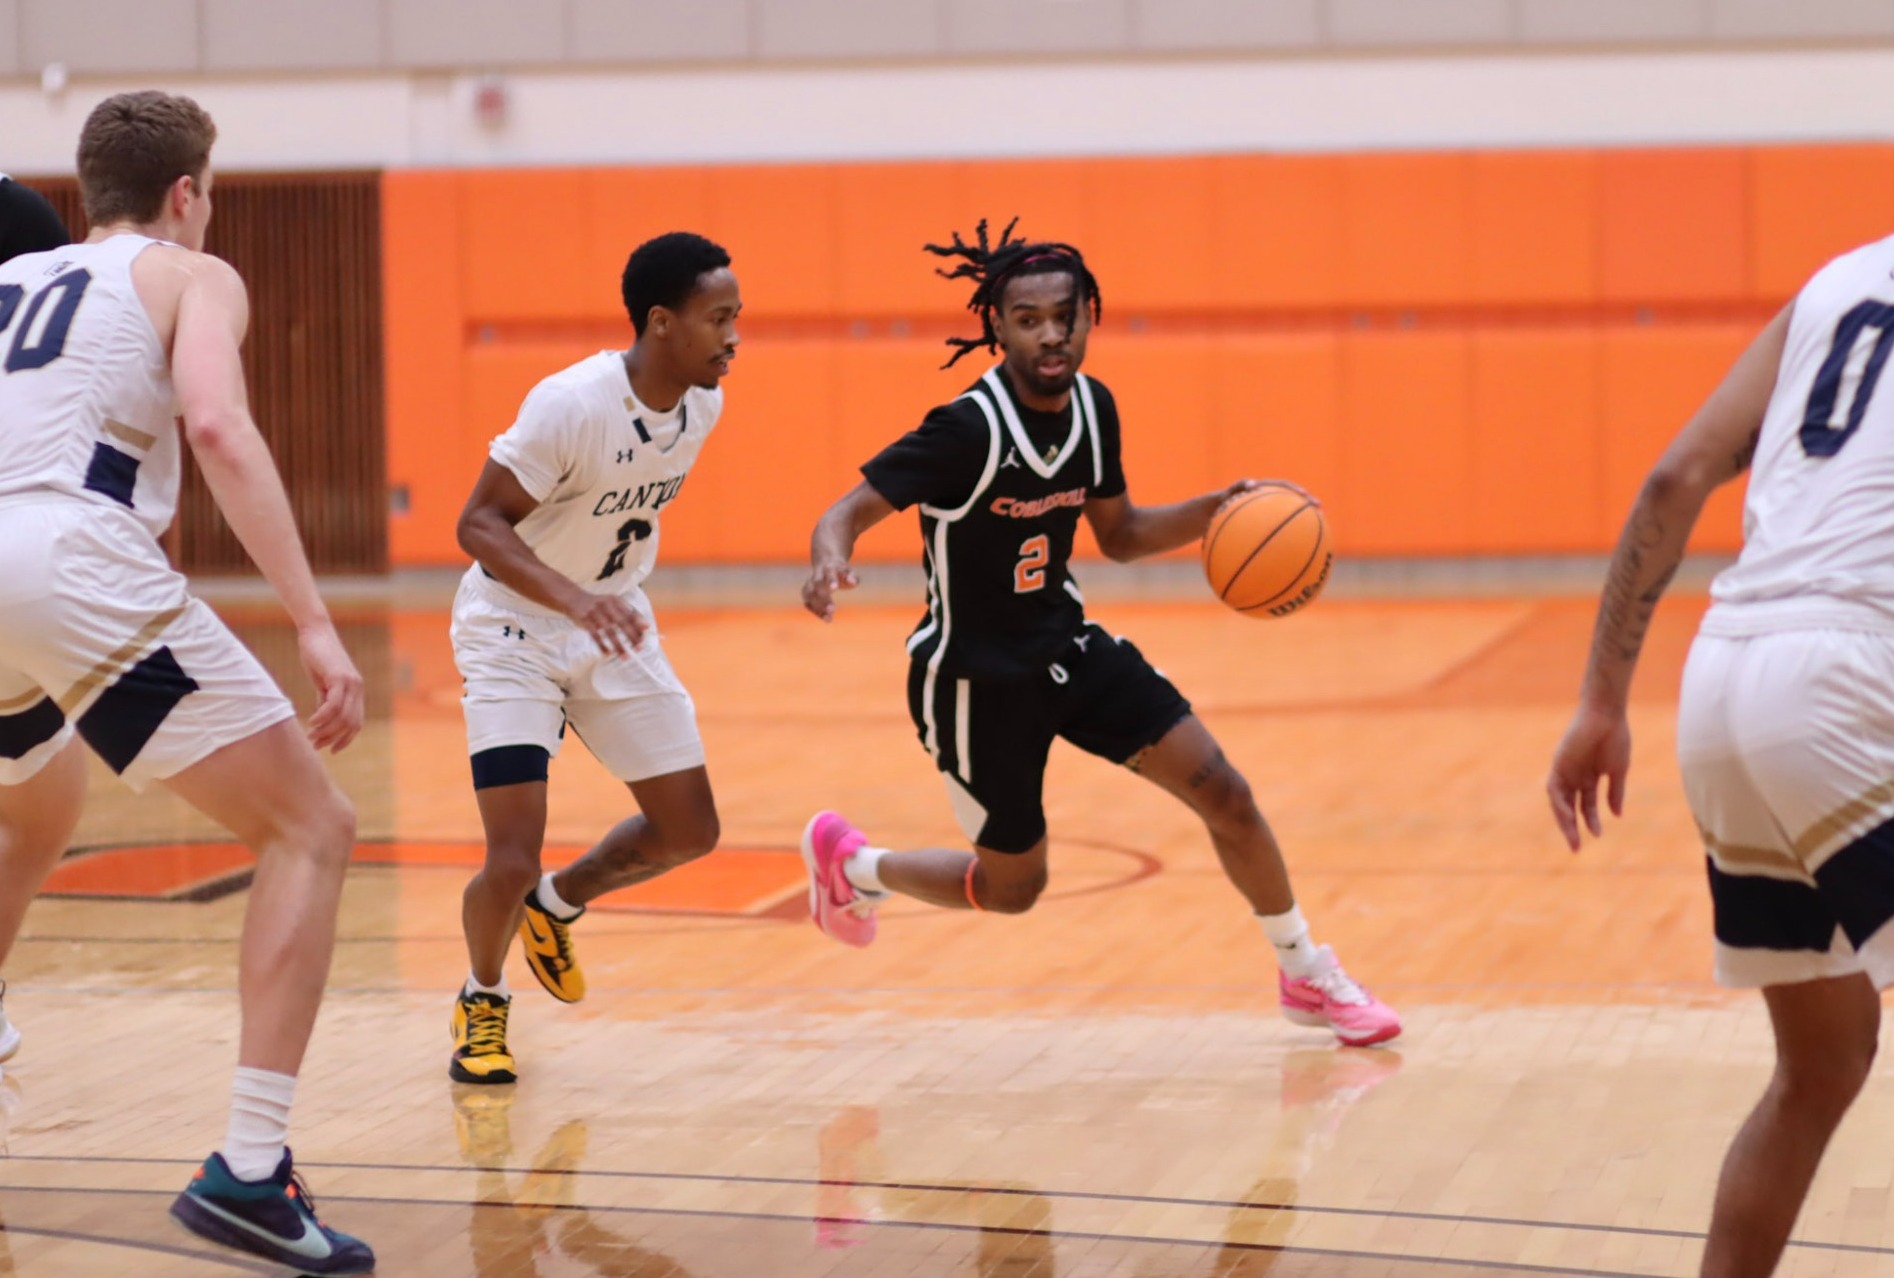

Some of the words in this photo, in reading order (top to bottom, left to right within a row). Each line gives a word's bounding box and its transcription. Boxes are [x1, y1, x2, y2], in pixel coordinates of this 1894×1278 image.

[1798, 298, 1894, 458] 0
[595, 517, 653, 582] 2
[1013, 533, 1050, 594] 2
